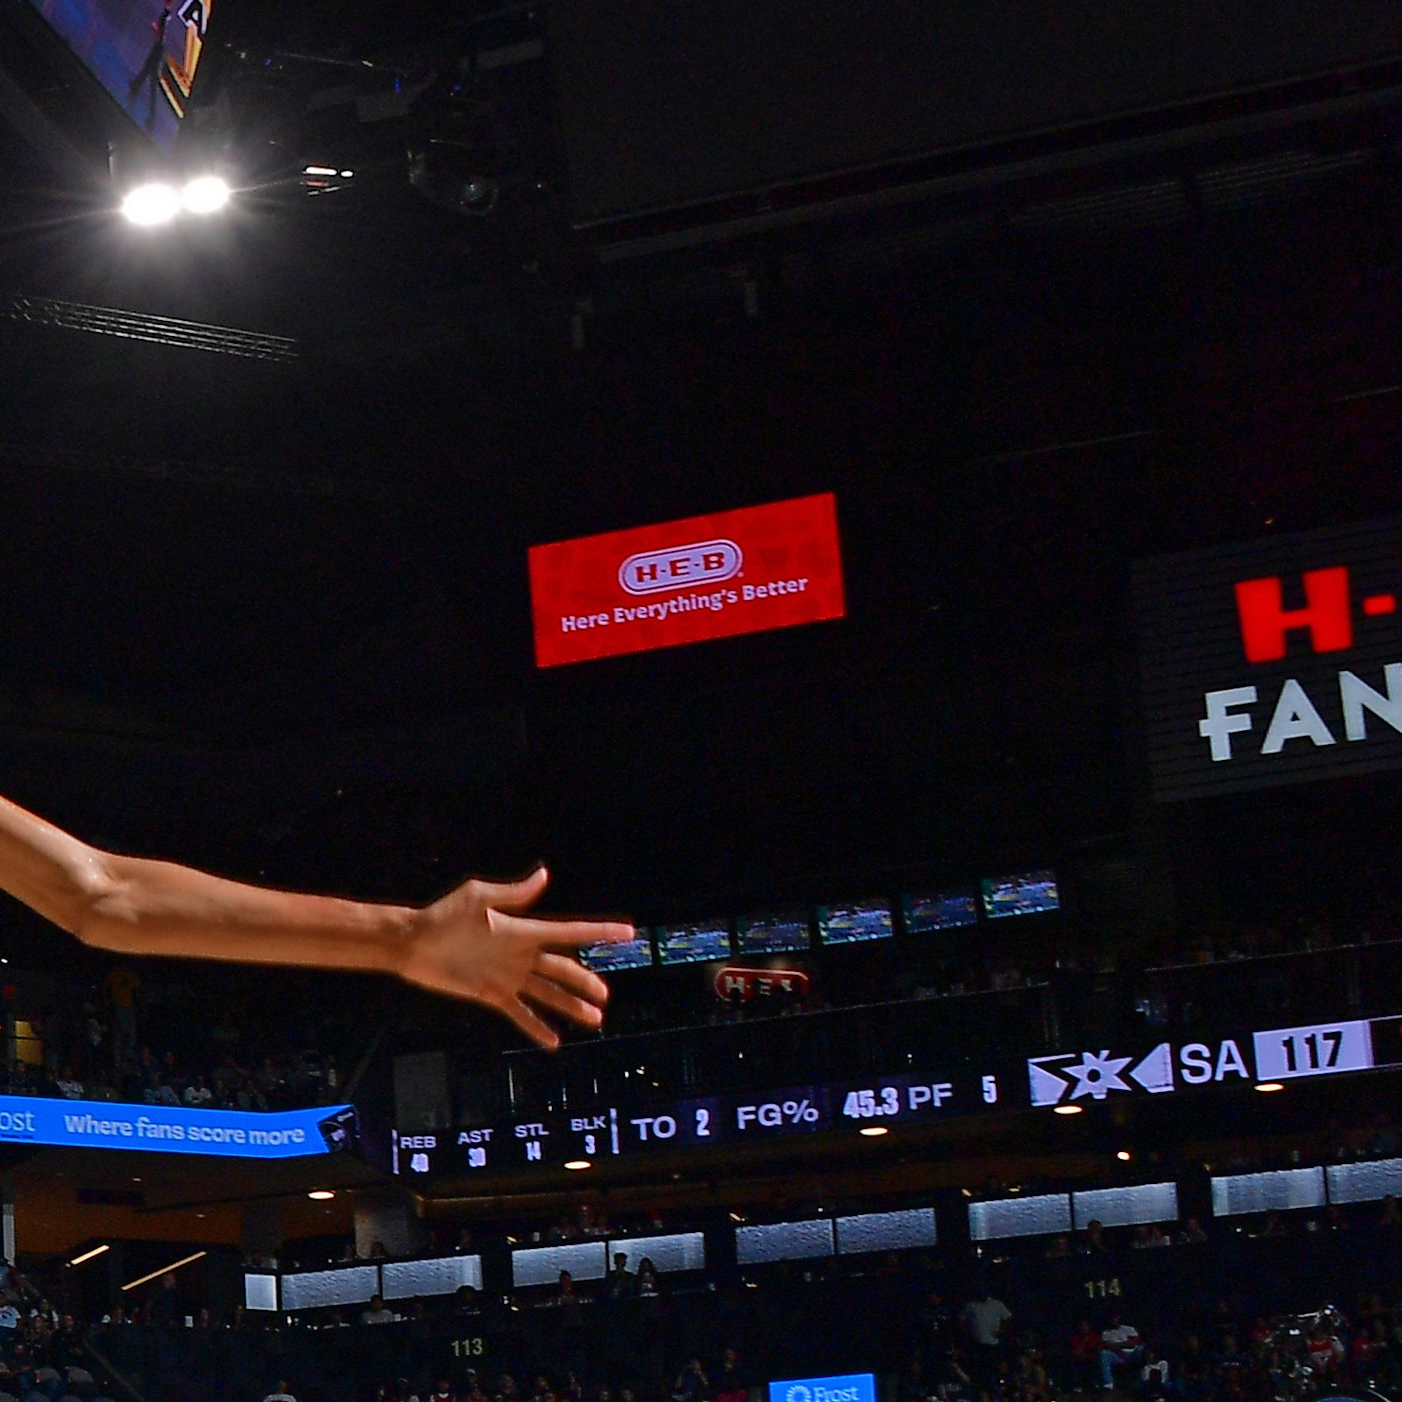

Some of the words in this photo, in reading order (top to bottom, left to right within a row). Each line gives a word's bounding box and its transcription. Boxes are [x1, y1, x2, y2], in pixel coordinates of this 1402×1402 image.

[561, 613, 610, 632] Here
[614, 589, 738, 621] Everything's
[743, 577, 808, 601] Better
[1234, 565, 1402, 664] H-
[1198, 662, 1402, 762] FAN
[1179, 1040, 1249, 1084] SA
[1282, 1031, 1344, 1072] 117
[737, 1100, 819, 1130] FG%
[843, 1088, 899, 1119] 45.3
[908, 1083, 953, 1110] PF
[981, 1075, 997, 1103] 5
[64, 1114, 132, 1136] Where
[135, 1117, 185, 1140] fans
[188, 1124, 245, 1143] score
[249, 1127, 305, 1146] more
[400, 1136, 436, 1149] REB
[457, 1129, 494, 1144] AST
[514, 1123, 550, 1138] STL
[571, 1116, 606, 1131] BLK
[631, 1116, 676, 1141] TO
[696, 1109, 710, 1136] 2
[1085, 1278, 1122, 1298] 114
[451, 1337, 484, 1357] 113
